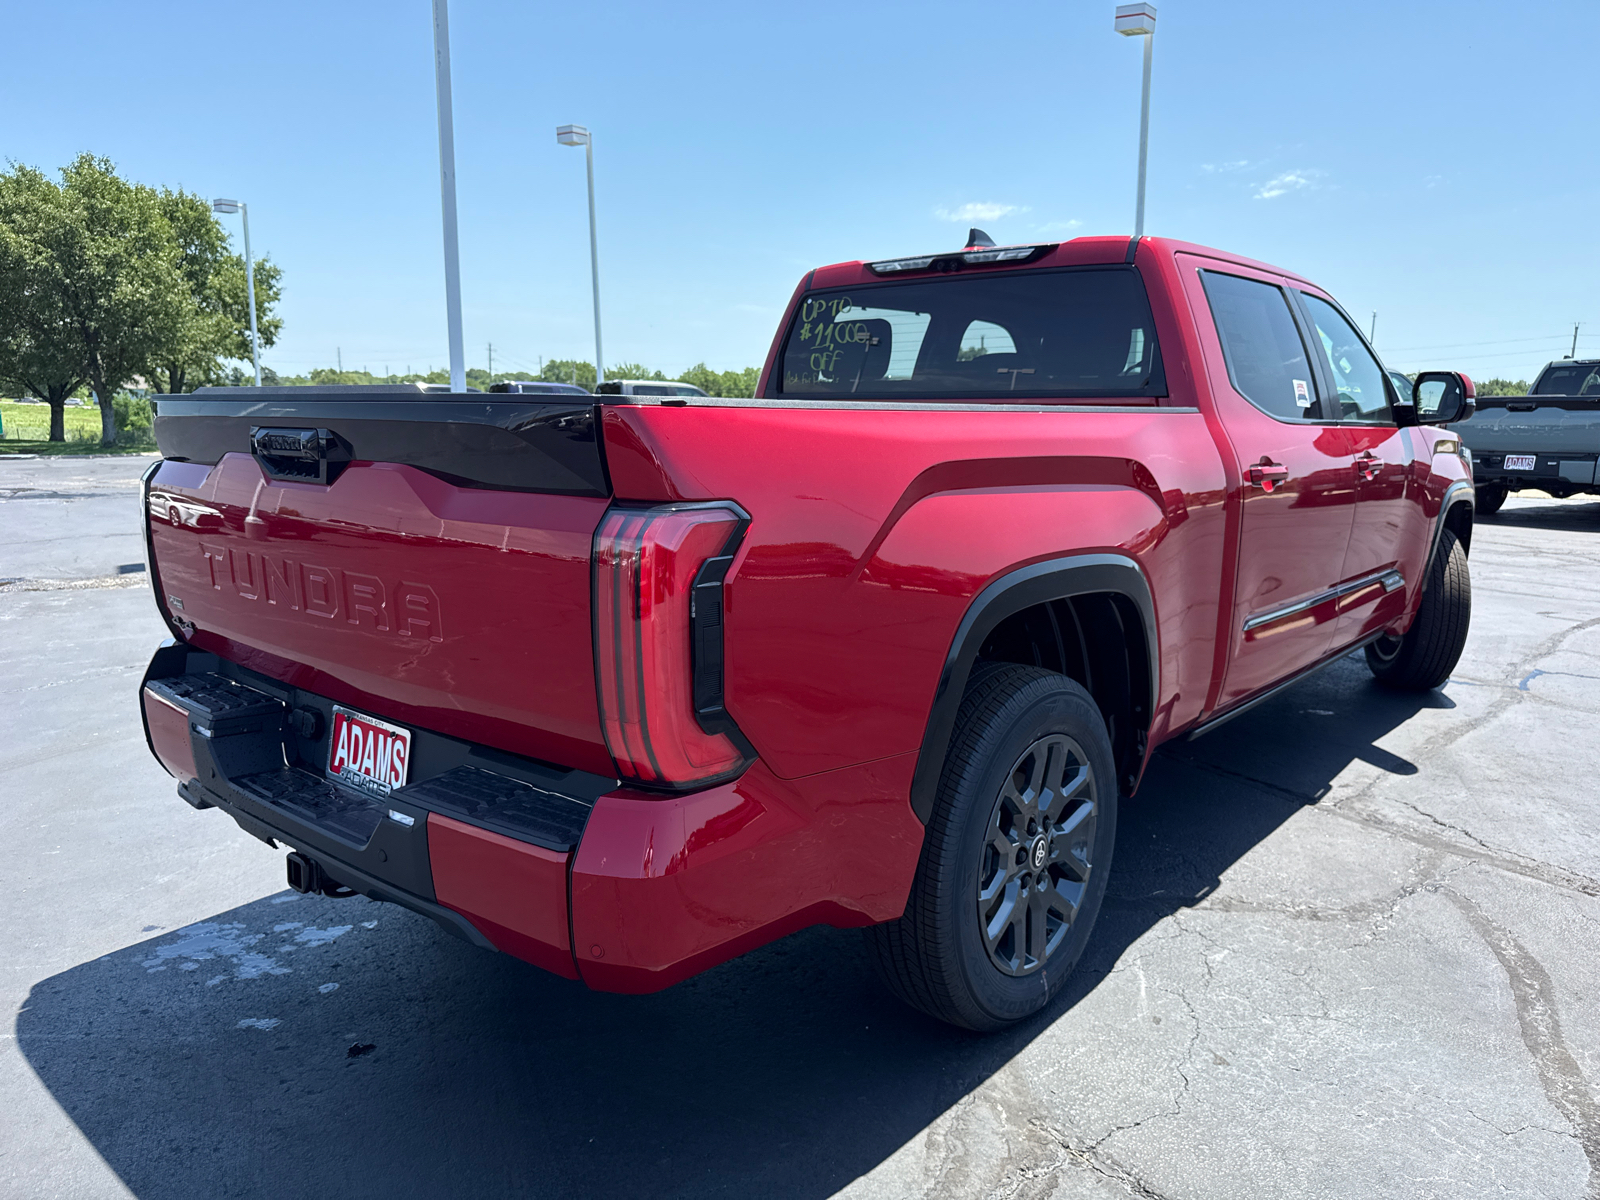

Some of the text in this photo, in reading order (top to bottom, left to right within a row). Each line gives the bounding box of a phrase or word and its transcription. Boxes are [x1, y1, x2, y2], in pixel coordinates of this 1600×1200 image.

[803, 297, 853, 322] UP TO
[810, 350, 844, 371] OFF
[1507, 458, 1533, 470] ADAMS
[199, 542, 443, 642] TUNDRA
[333, 720, 405, 791] ADAMS
